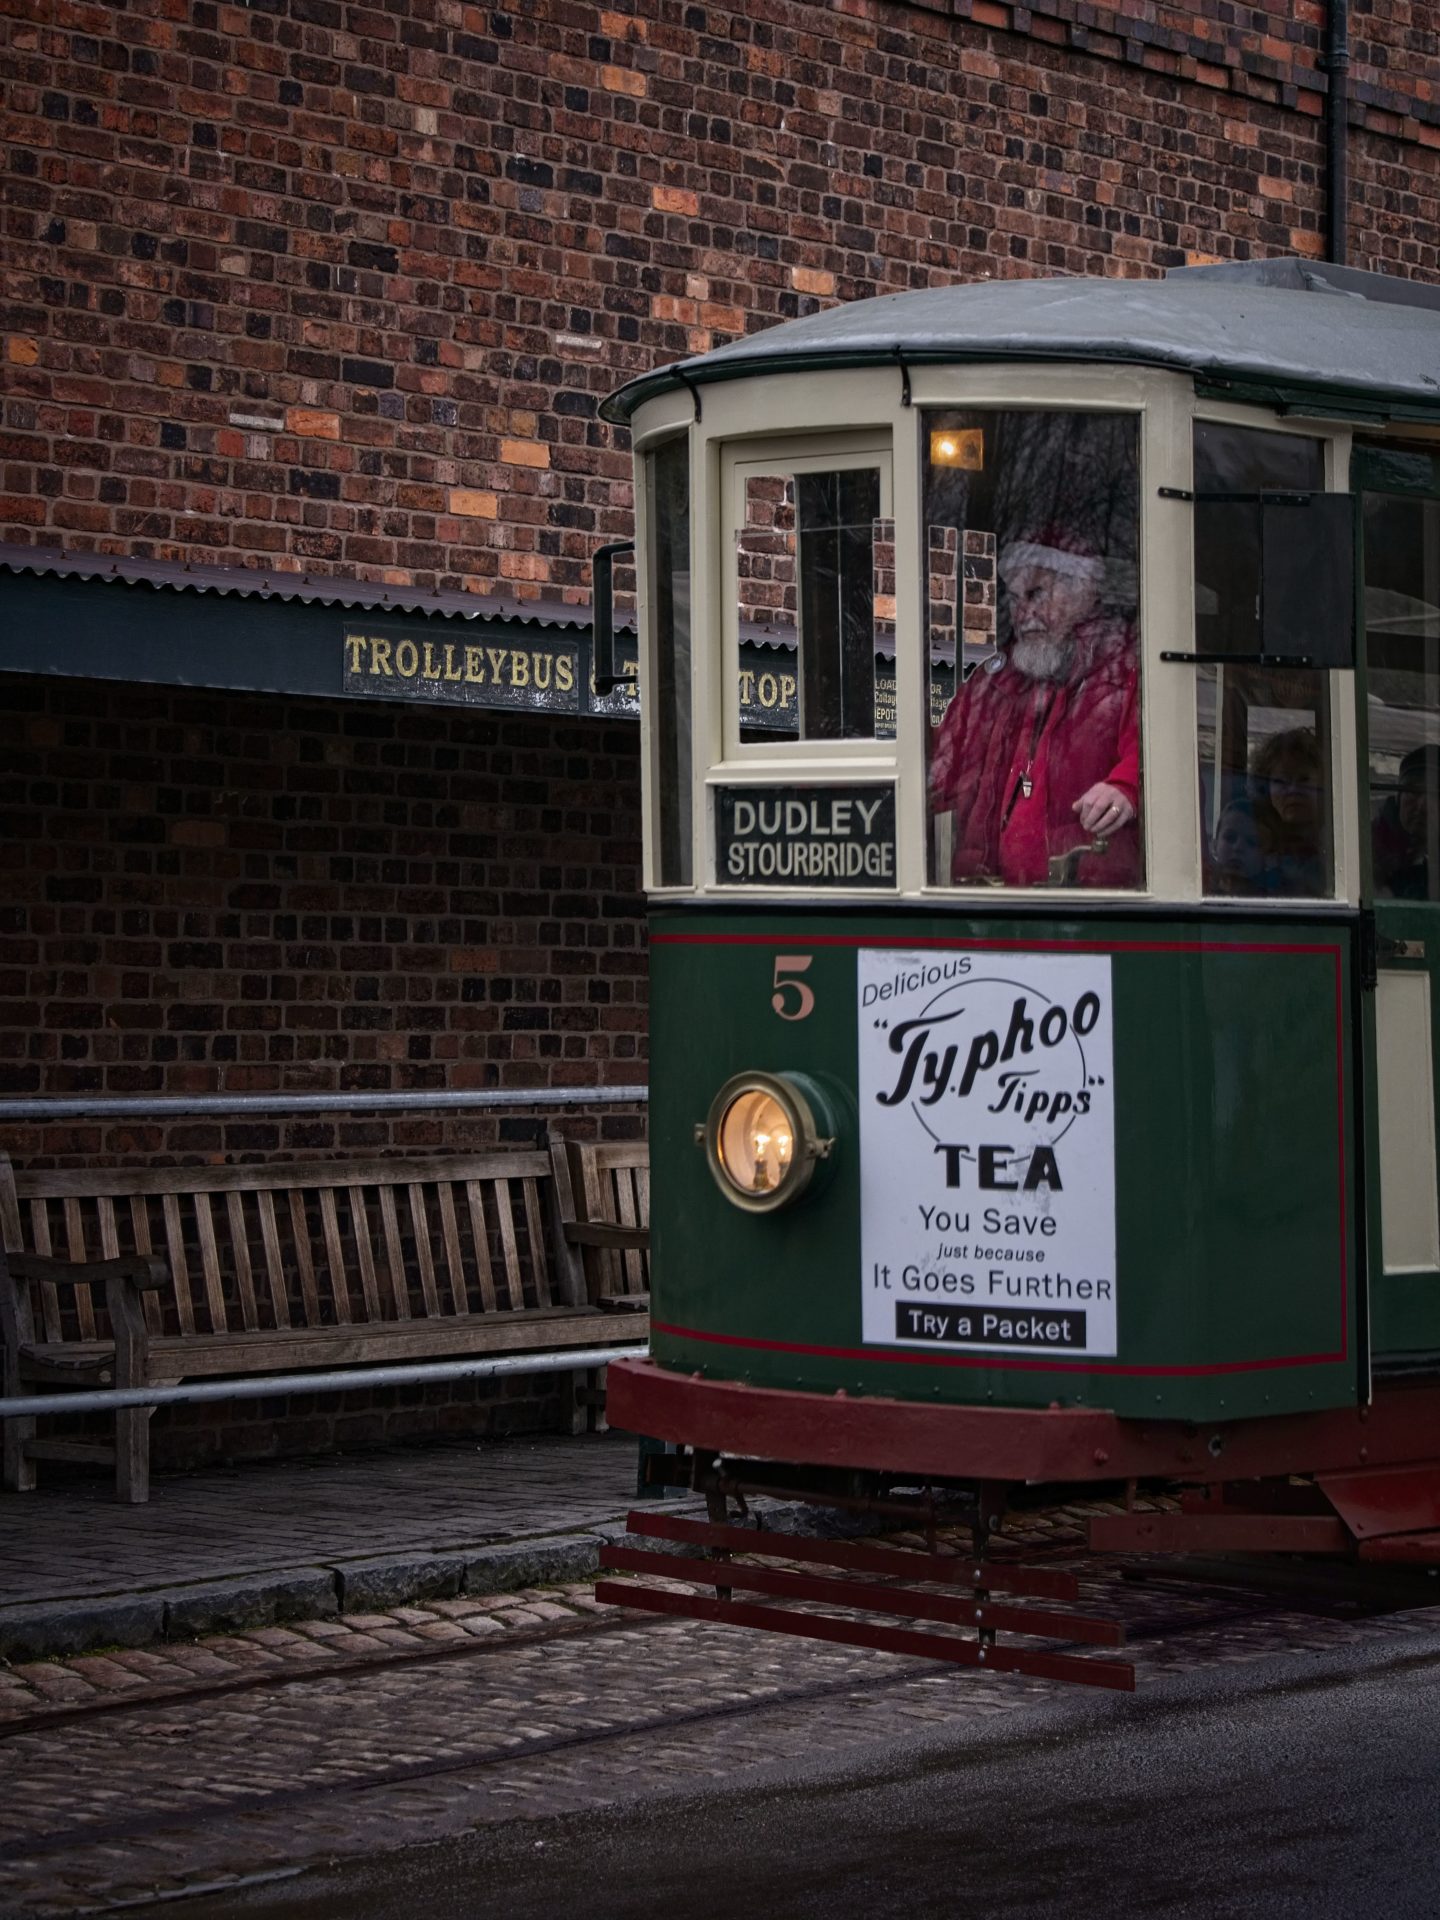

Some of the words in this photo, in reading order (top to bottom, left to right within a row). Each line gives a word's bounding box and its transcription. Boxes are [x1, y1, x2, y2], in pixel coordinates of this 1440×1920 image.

[345, 634, 575, 691] TROLLEYBUS
[738, 670, 796, 708] TOP
[875, 678, 896, 690] LOAD
[930, 683, 942, 695] OR
[875, 707, 896, 721] EPOT
[733, 799, 883, 836] DUDLEY
[727, 841, 894, 877] STOURBRIDGE
[771, 954, 815, 1021] 5
[861, 956, 973, 1008] Delicious
[933, 1143, 1063, 1192] TEA
[918, 1204, 970, 1233] You
[983, 1207, 1057, 1237] Save
[936, 1243, 968, 1261] just
[974, 1244, 1046, 1263] because
[873, 1262, 892, 1290] It
[901, 1264, 975, 1294] Goes
[957, 1316, 972, 1337] a
[982, 1313, 1072, 1342] Packet
